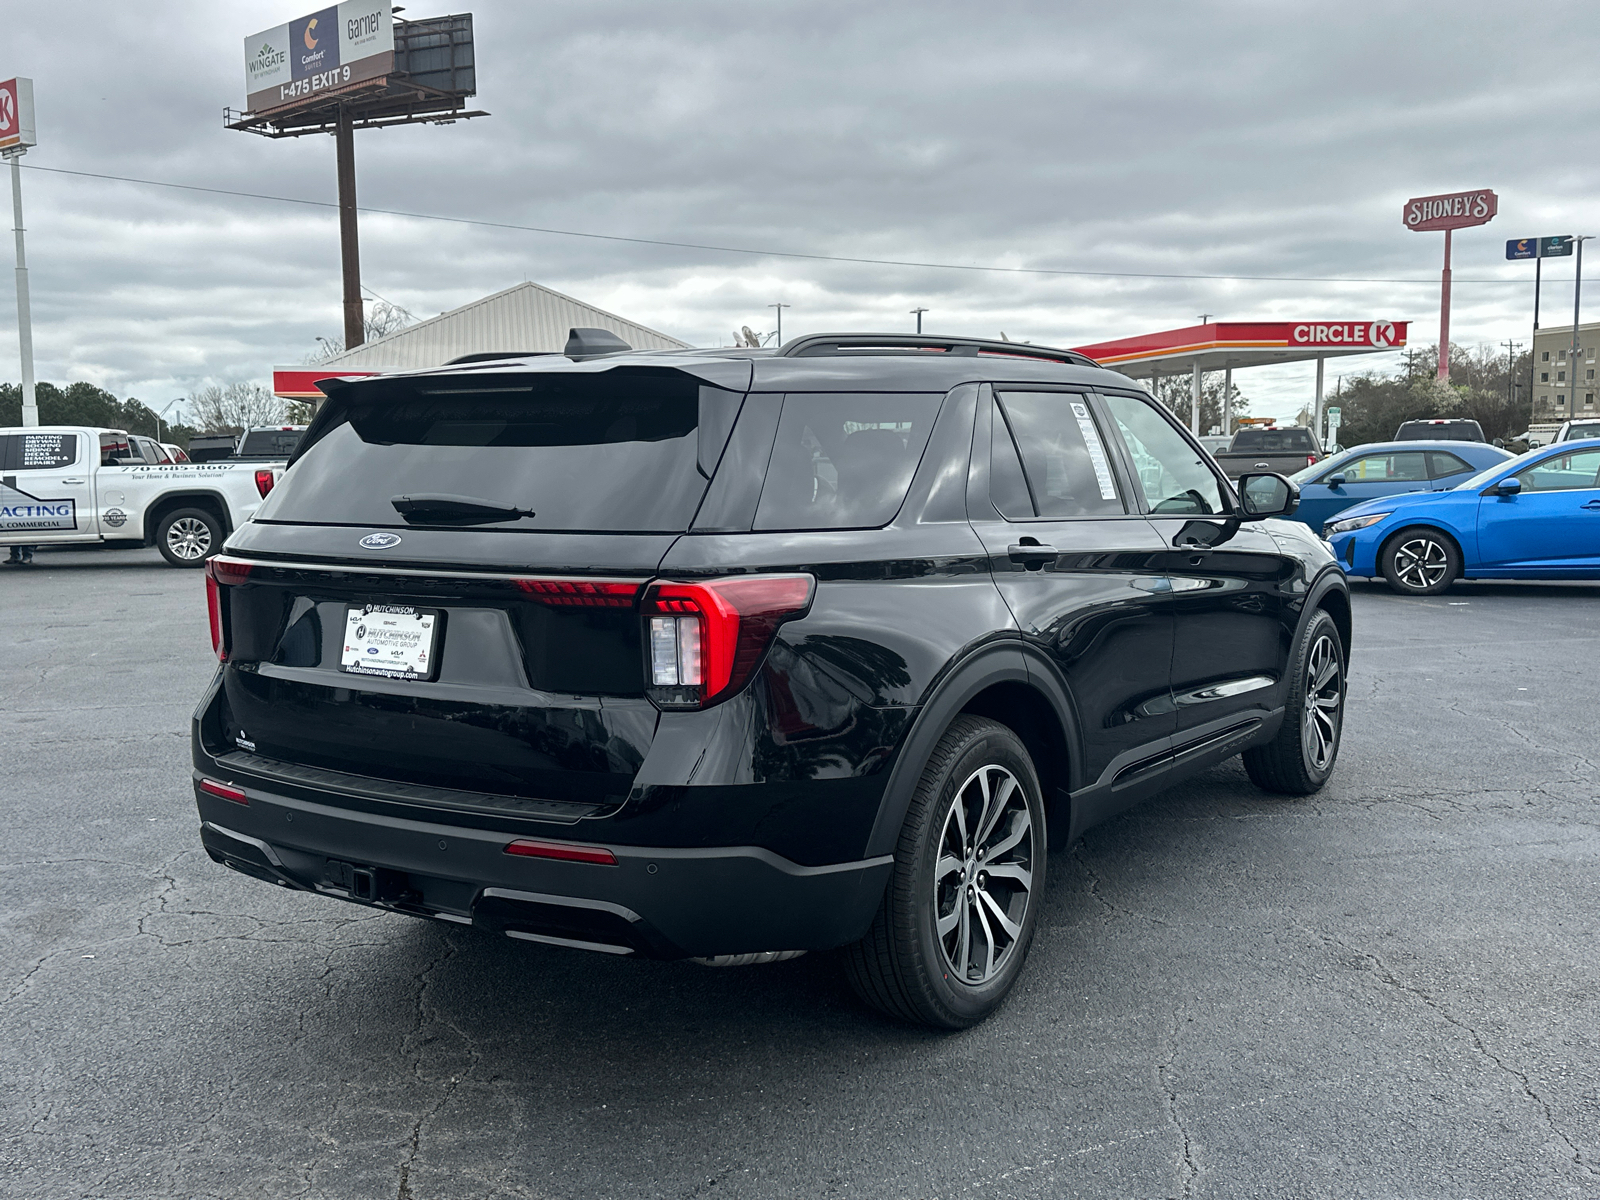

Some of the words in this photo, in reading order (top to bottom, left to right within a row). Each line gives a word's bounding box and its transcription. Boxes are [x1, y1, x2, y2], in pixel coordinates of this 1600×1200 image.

[347, 10, 382, 40] Garner
[249, 51, 285, 73] WINGATE
[301, 51, 325, 64] Comfort
[260, 66, 281, 78] WYNDHAM
[304, 61, 322, 71] SUITES
[280, 79, 310, 101] I-475
[312, 69, 341, 90] EXIT
[343, 66, 351, 81] 9
[1408, 194, 1489, 225] SHONEY'S
[1294, 325, 1365, 343] CIRCLE
[1375, 324, 1394, 347] K
[0, 505, 70, 517] ACTING
[373, 605, 414, 614] HUTCHINSON
[367, 638, 398, 647] AUTOMOTIVE
[346, 665, 418, 679] Hutchinsonautogroup.com
